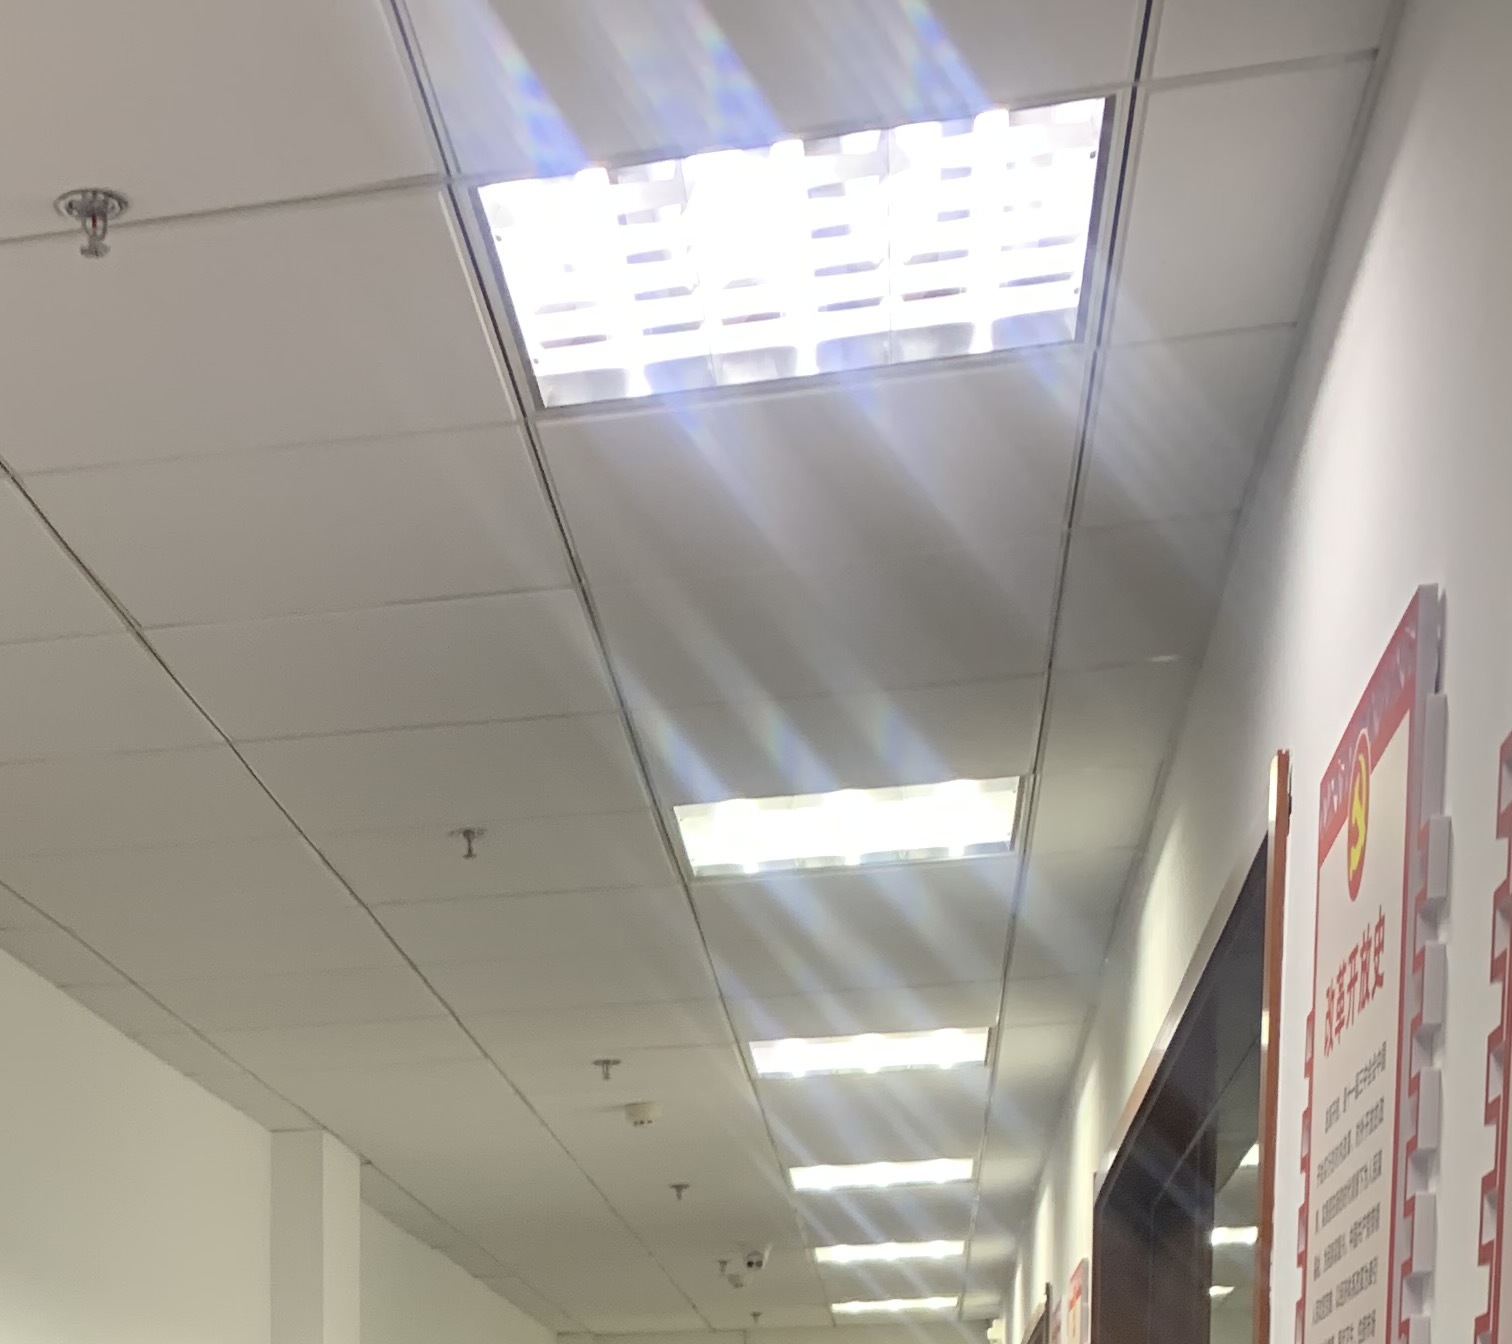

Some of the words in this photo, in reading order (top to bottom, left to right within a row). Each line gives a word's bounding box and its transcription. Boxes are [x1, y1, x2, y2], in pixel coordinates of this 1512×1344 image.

[1323, 905, 1386, 1057] 改革开放史
